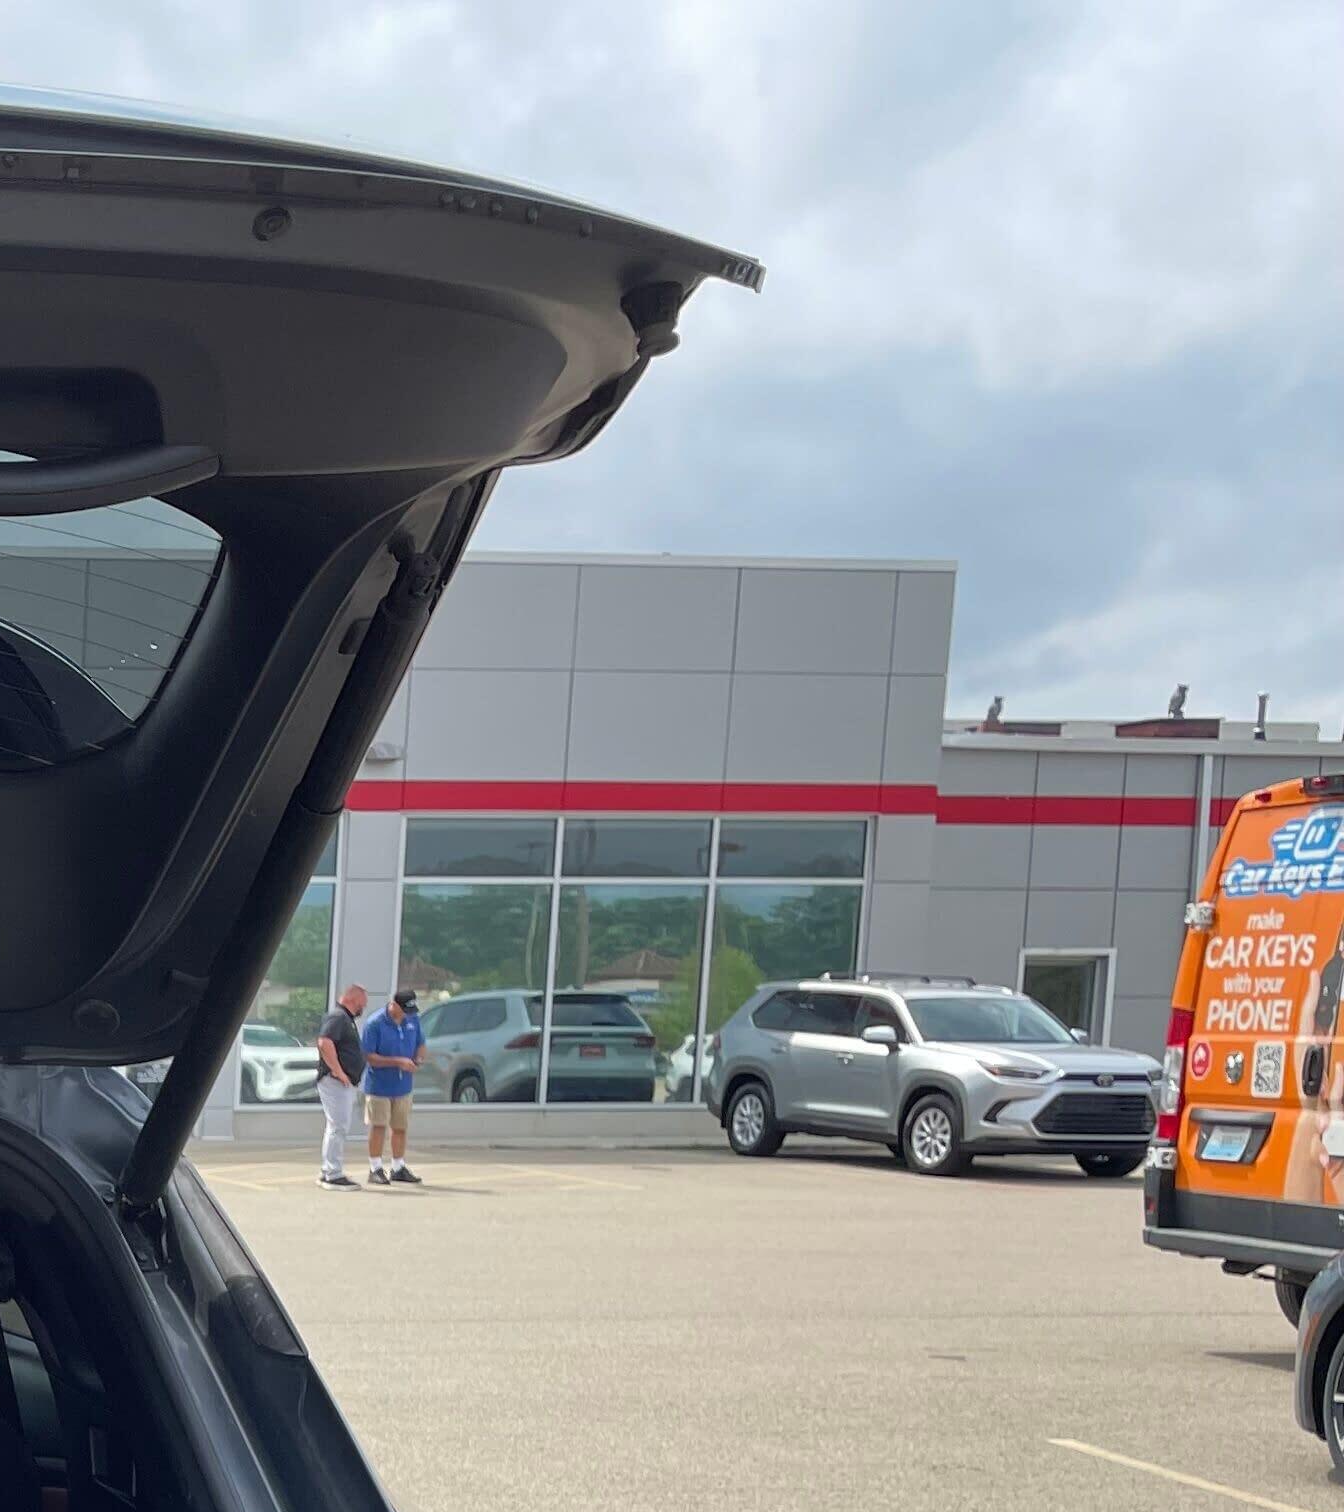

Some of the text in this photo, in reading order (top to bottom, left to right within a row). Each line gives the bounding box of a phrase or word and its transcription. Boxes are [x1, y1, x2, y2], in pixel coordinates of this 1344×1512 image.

[1224, 862, 1267, 893] Car
[1267, 860, 1326, 895] Keys
[1246, 907, 1285, 930] make
[1205, 934, 1317, 968] CAR KEYS
[1223, 972, 1285, 998] with your
[1205, 999, 1293, 1032] PHONE!
